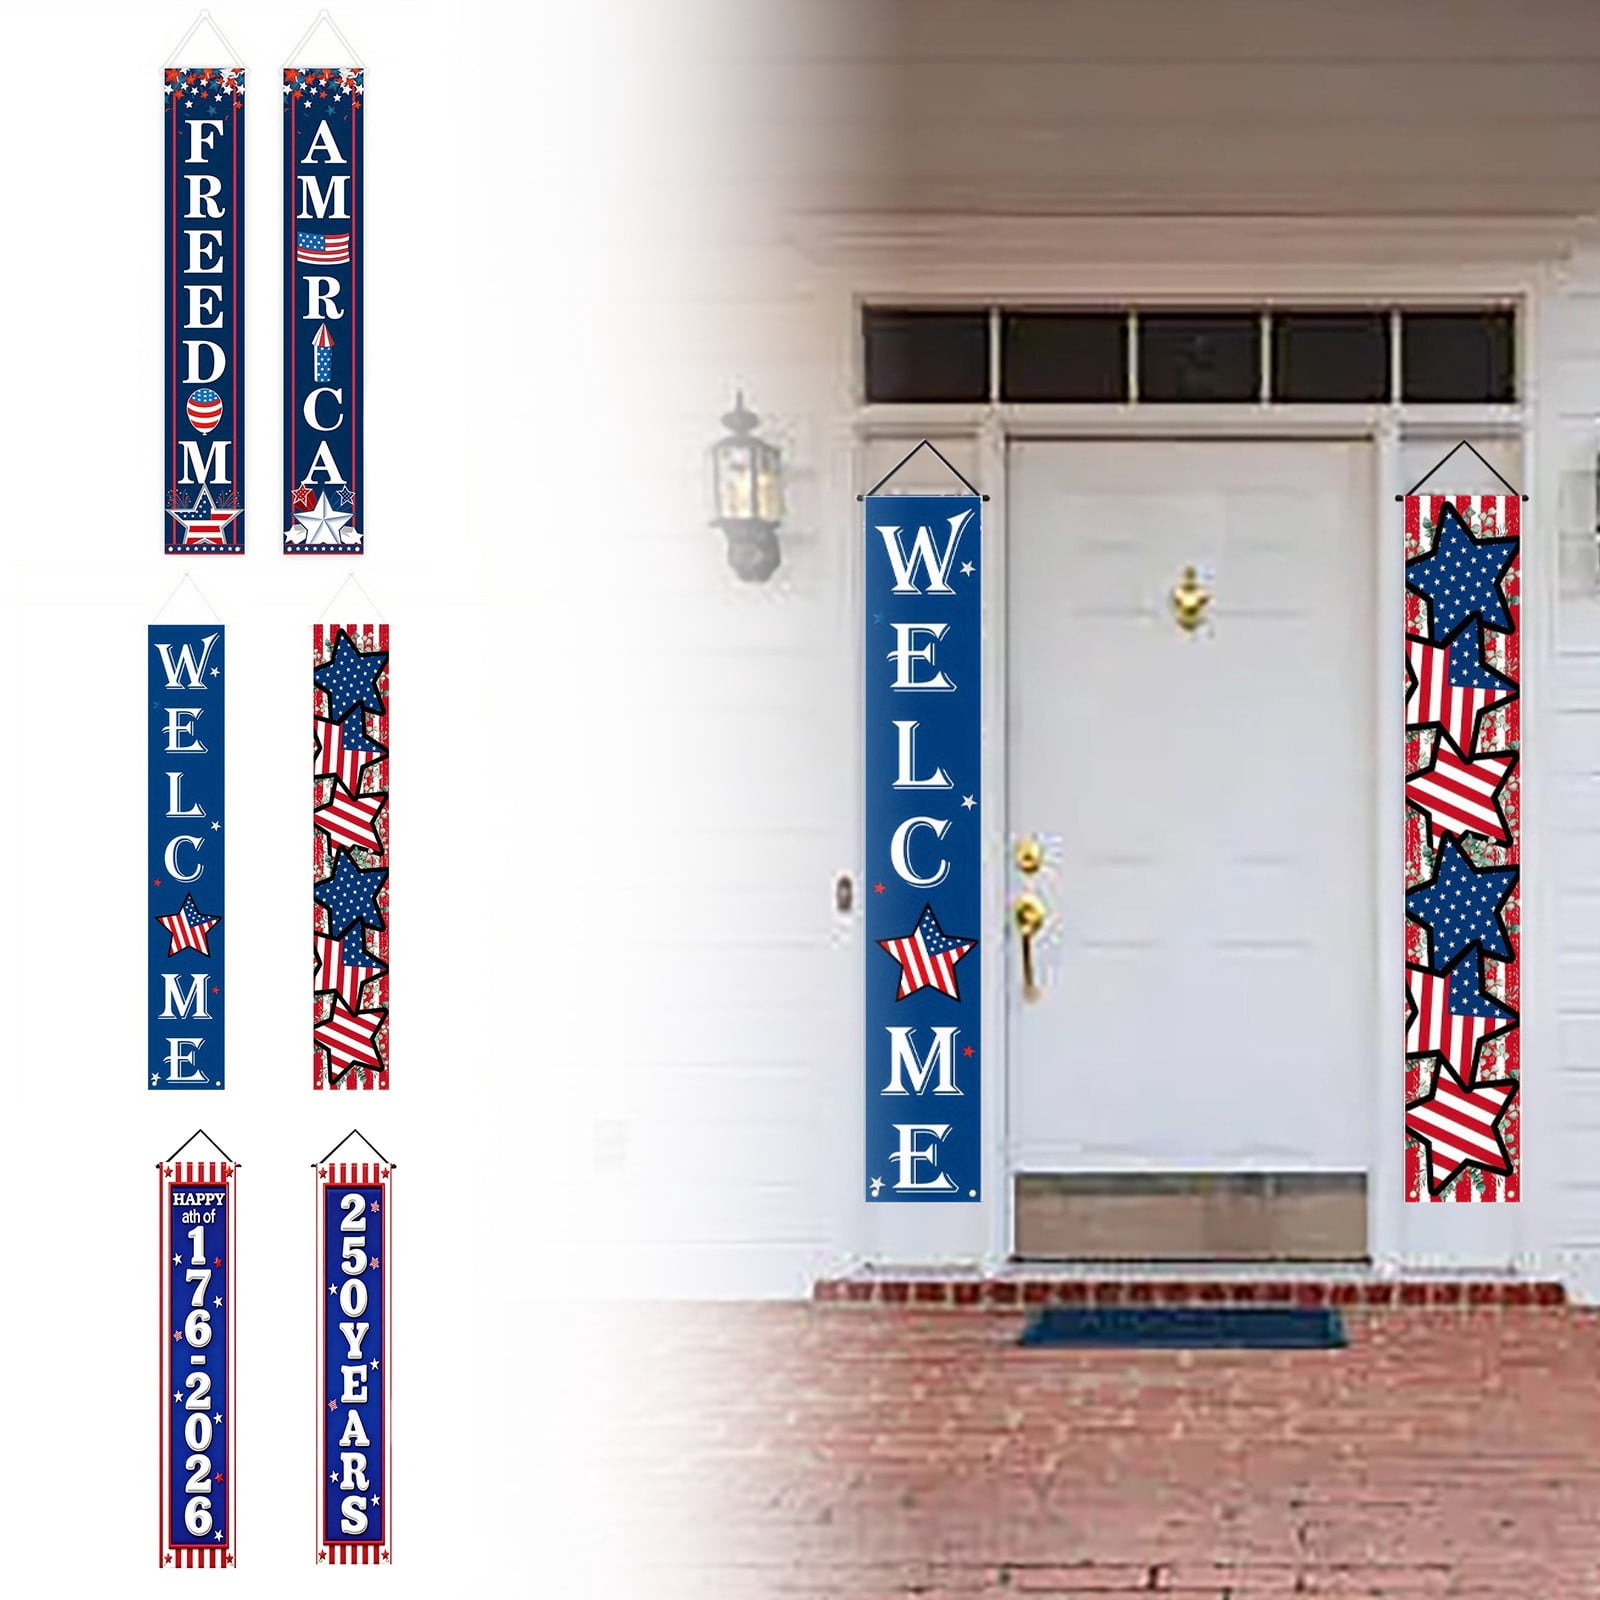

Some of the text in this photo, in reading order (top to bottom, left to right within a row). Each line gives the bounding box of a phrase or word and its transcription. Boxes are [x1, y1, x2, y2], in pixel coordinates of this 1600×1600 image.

[177, 119, 232, 485] FREEDM
[155, 633, 219, 1084] WELCME
[876, 509, 974, 1197] WELCME
[172, 1192, 226, 1206] HAPPY
[181, 1208, 216, 1224] ath of
[185, 1225, 213, 1537] 176-2026
